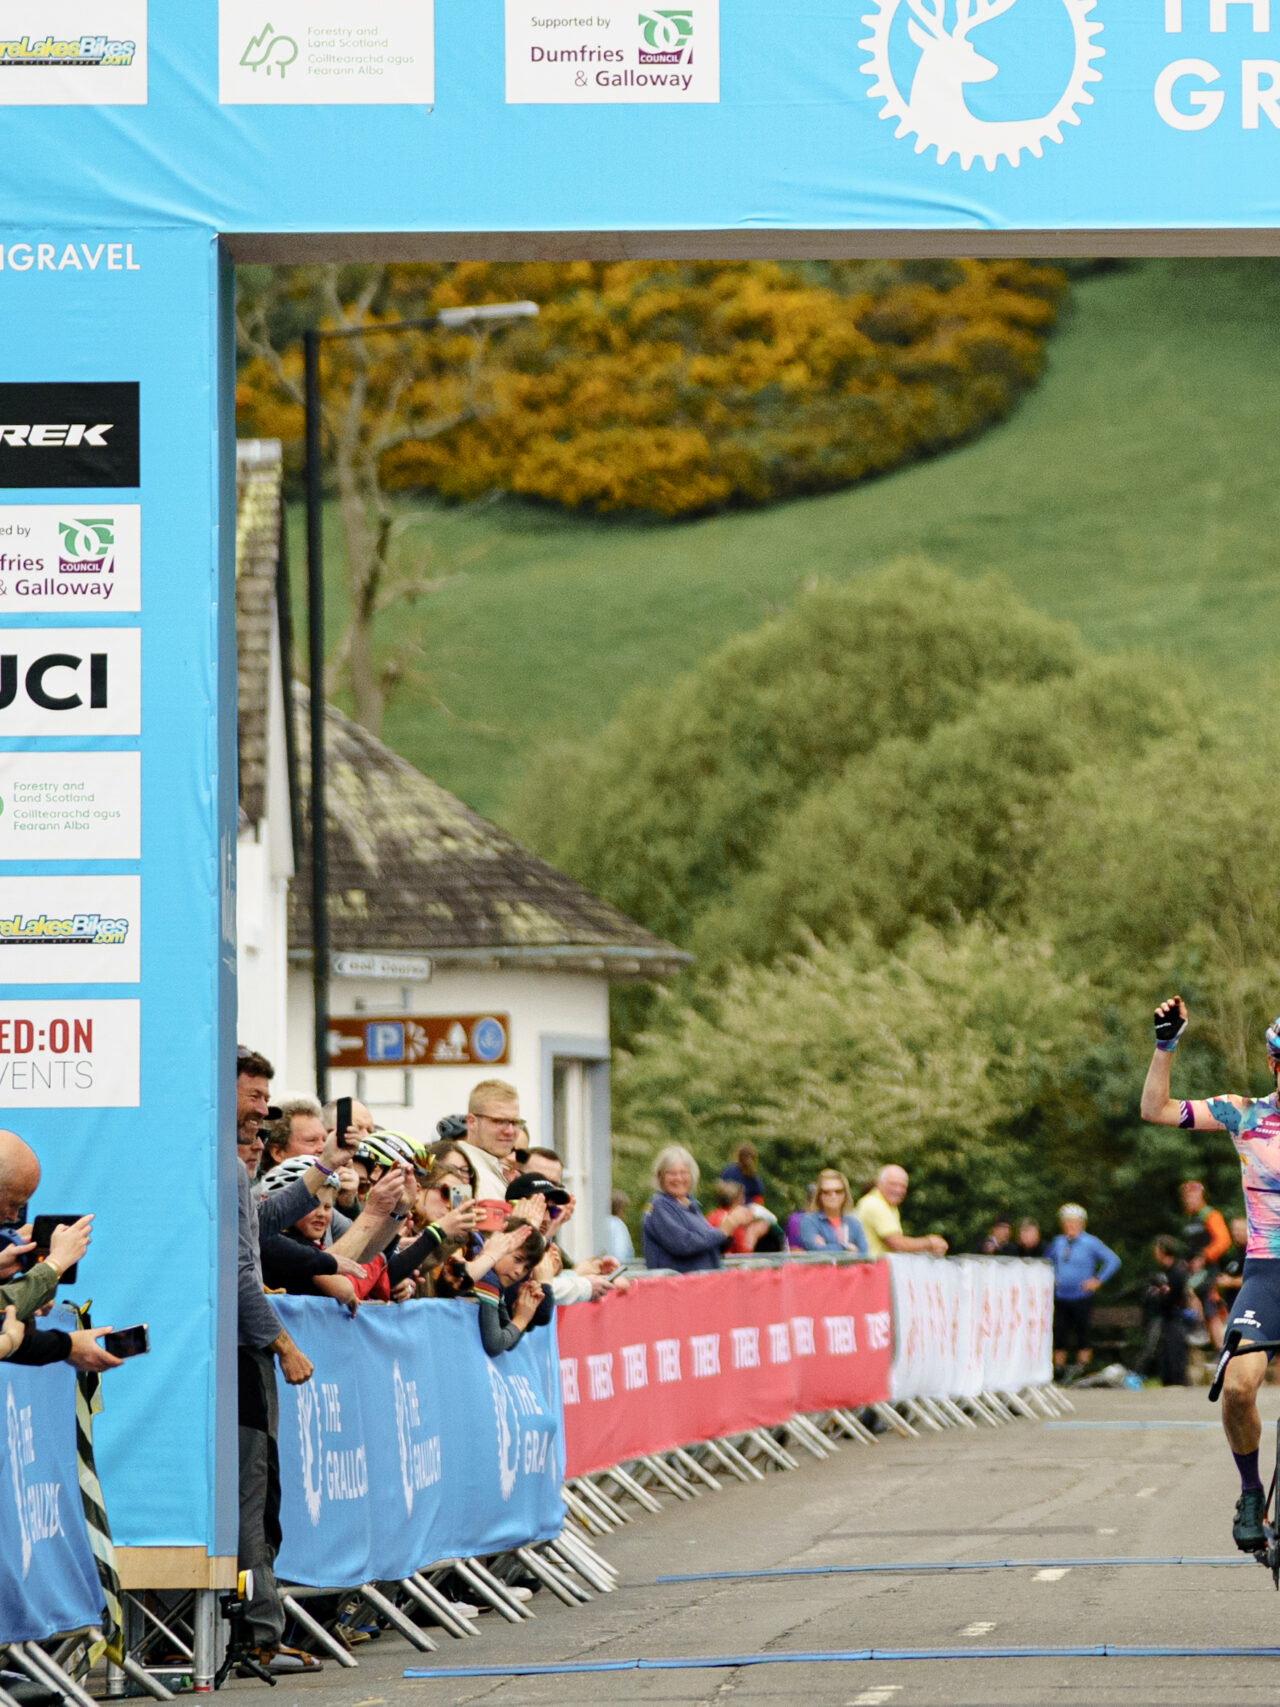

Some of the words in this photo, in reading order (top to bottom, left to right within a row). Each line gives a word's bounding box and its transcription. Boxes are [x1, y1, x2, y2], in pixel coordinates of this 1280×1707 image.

[530, 16, 594, 29] Supported
[597, 16, 611, 29] by
[308, 26, 352, 37] Forestry
[356, 26, 379, 36] and
[308, 39, 335, 48] Land
[339, 39, 388, 48] Scotland
[530, 45, 625, 62] Dumfries
[640, 54, 681, 64] COUNCIL
[387, 56, 415, 67] agus
[308, 66, 354, 76] Fearann
[358, 66, 384, 75] Alba
[574, 70, 589, 87] &
[595, 70, 693, 90] Galloway
[17, 525, 31, 538] by
[60, 563, 101, 572] COUNCIL
[15, 578, 114, 599] Galloway
[13, 781, 59, 793] Forestry
[63, 781, 85, 791] and
[13, 793, 41, 803] Land
[45, 793, 95, 803] Scotland
[13, 808, 90, 819] Coilltearachd
[93, 811, 121, 822] agus
[13, 821, 60, 831] Fearann
[64, 821, 90, 831] Alba
[689, 1333, 721, 1379] TREK
[730, 1326, 760, 1370] TREK
[822, 1315, 858, 1355] TREK
